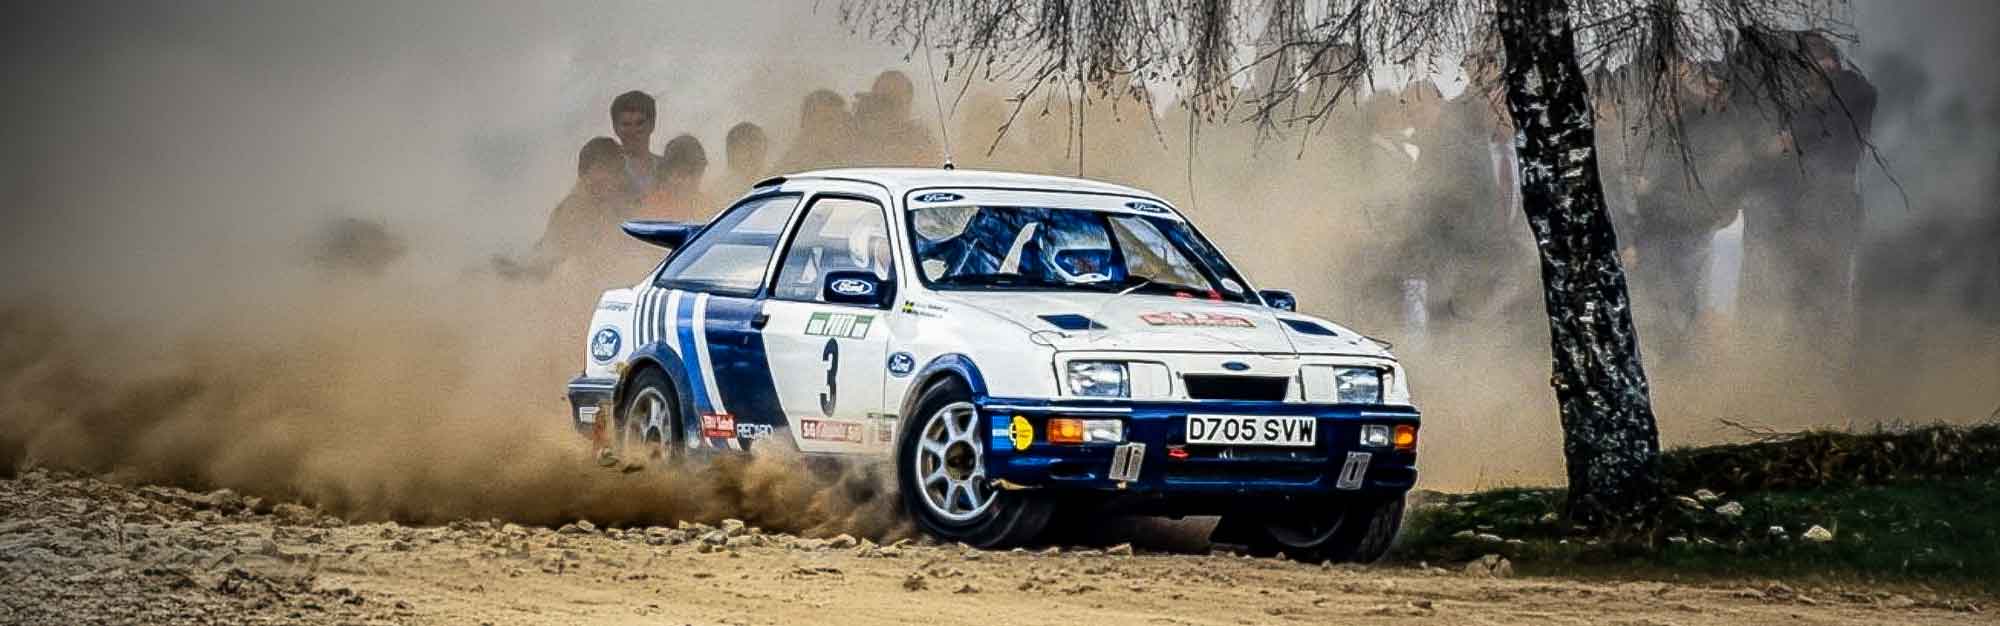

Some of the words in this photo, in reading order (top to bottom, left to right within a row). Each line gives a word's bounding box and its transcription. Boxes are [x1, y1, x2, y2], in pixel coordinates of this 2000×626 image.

[838, 281, 865, 292] Ford
[820, 337, 839, 417] 3
[1189, 417, 1257, 441] D705
[1263, 418, 1314, 443] SVW
